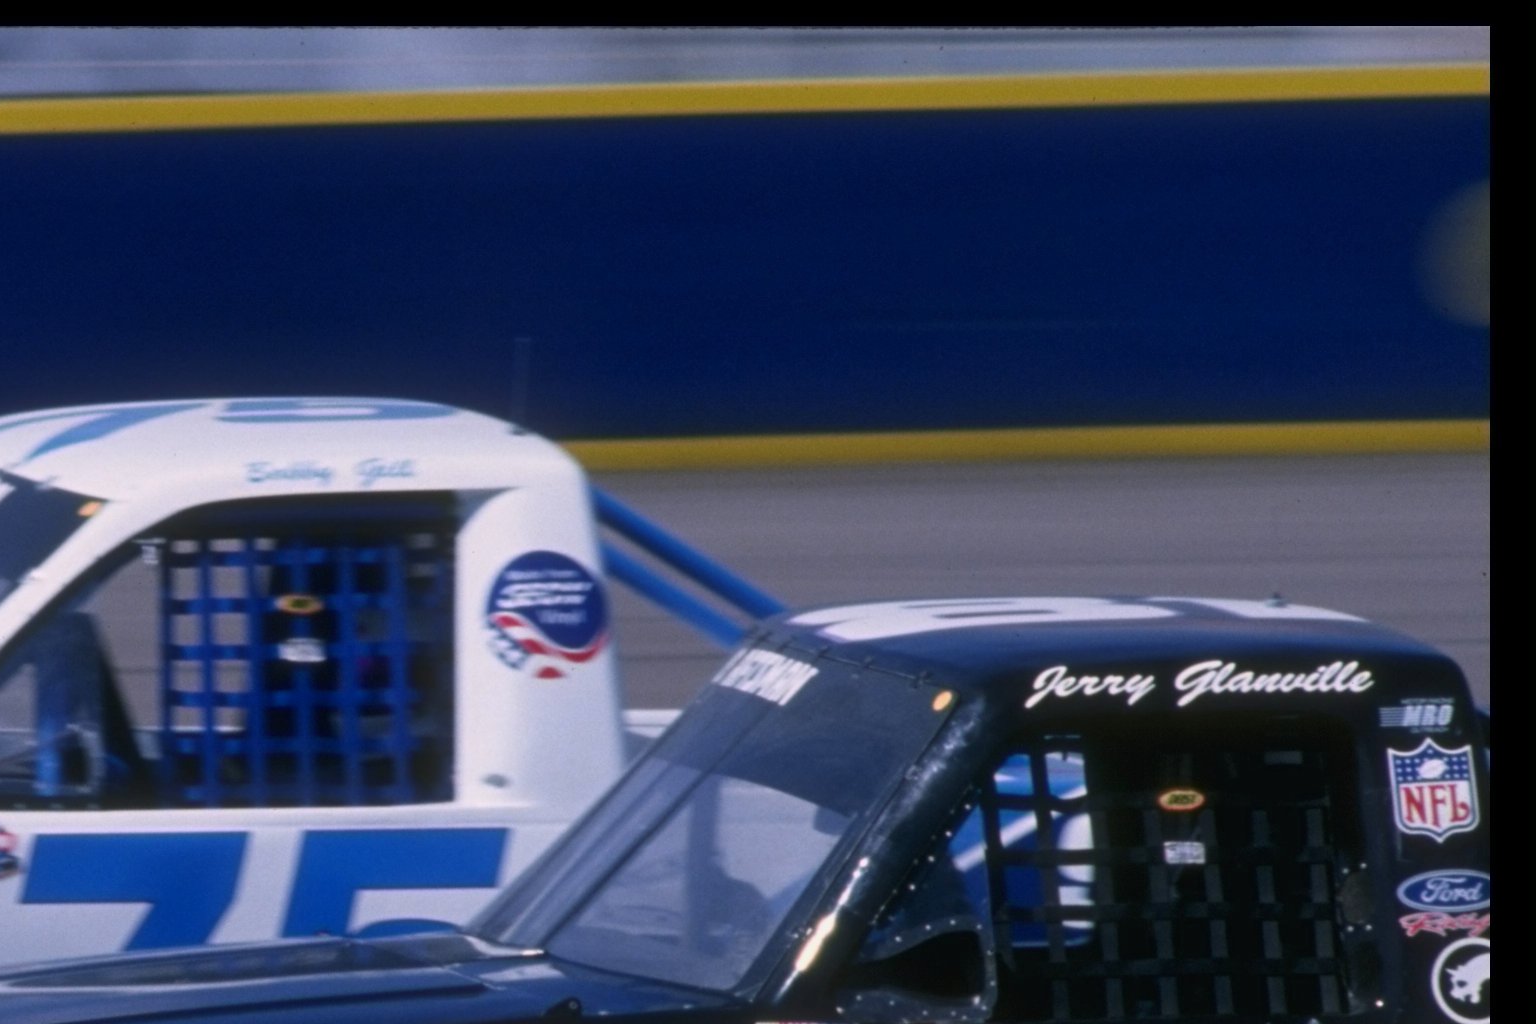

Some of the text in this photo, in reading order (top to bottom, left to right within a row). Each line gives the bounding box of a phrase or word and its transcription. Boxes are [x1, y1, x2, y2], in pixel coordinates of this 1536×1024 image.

[1024, 660, 1374, 708] Jerry Glanville
[1402, 783, 1471, 828] NFL
[1421, 876, 1484, 903] Ford
